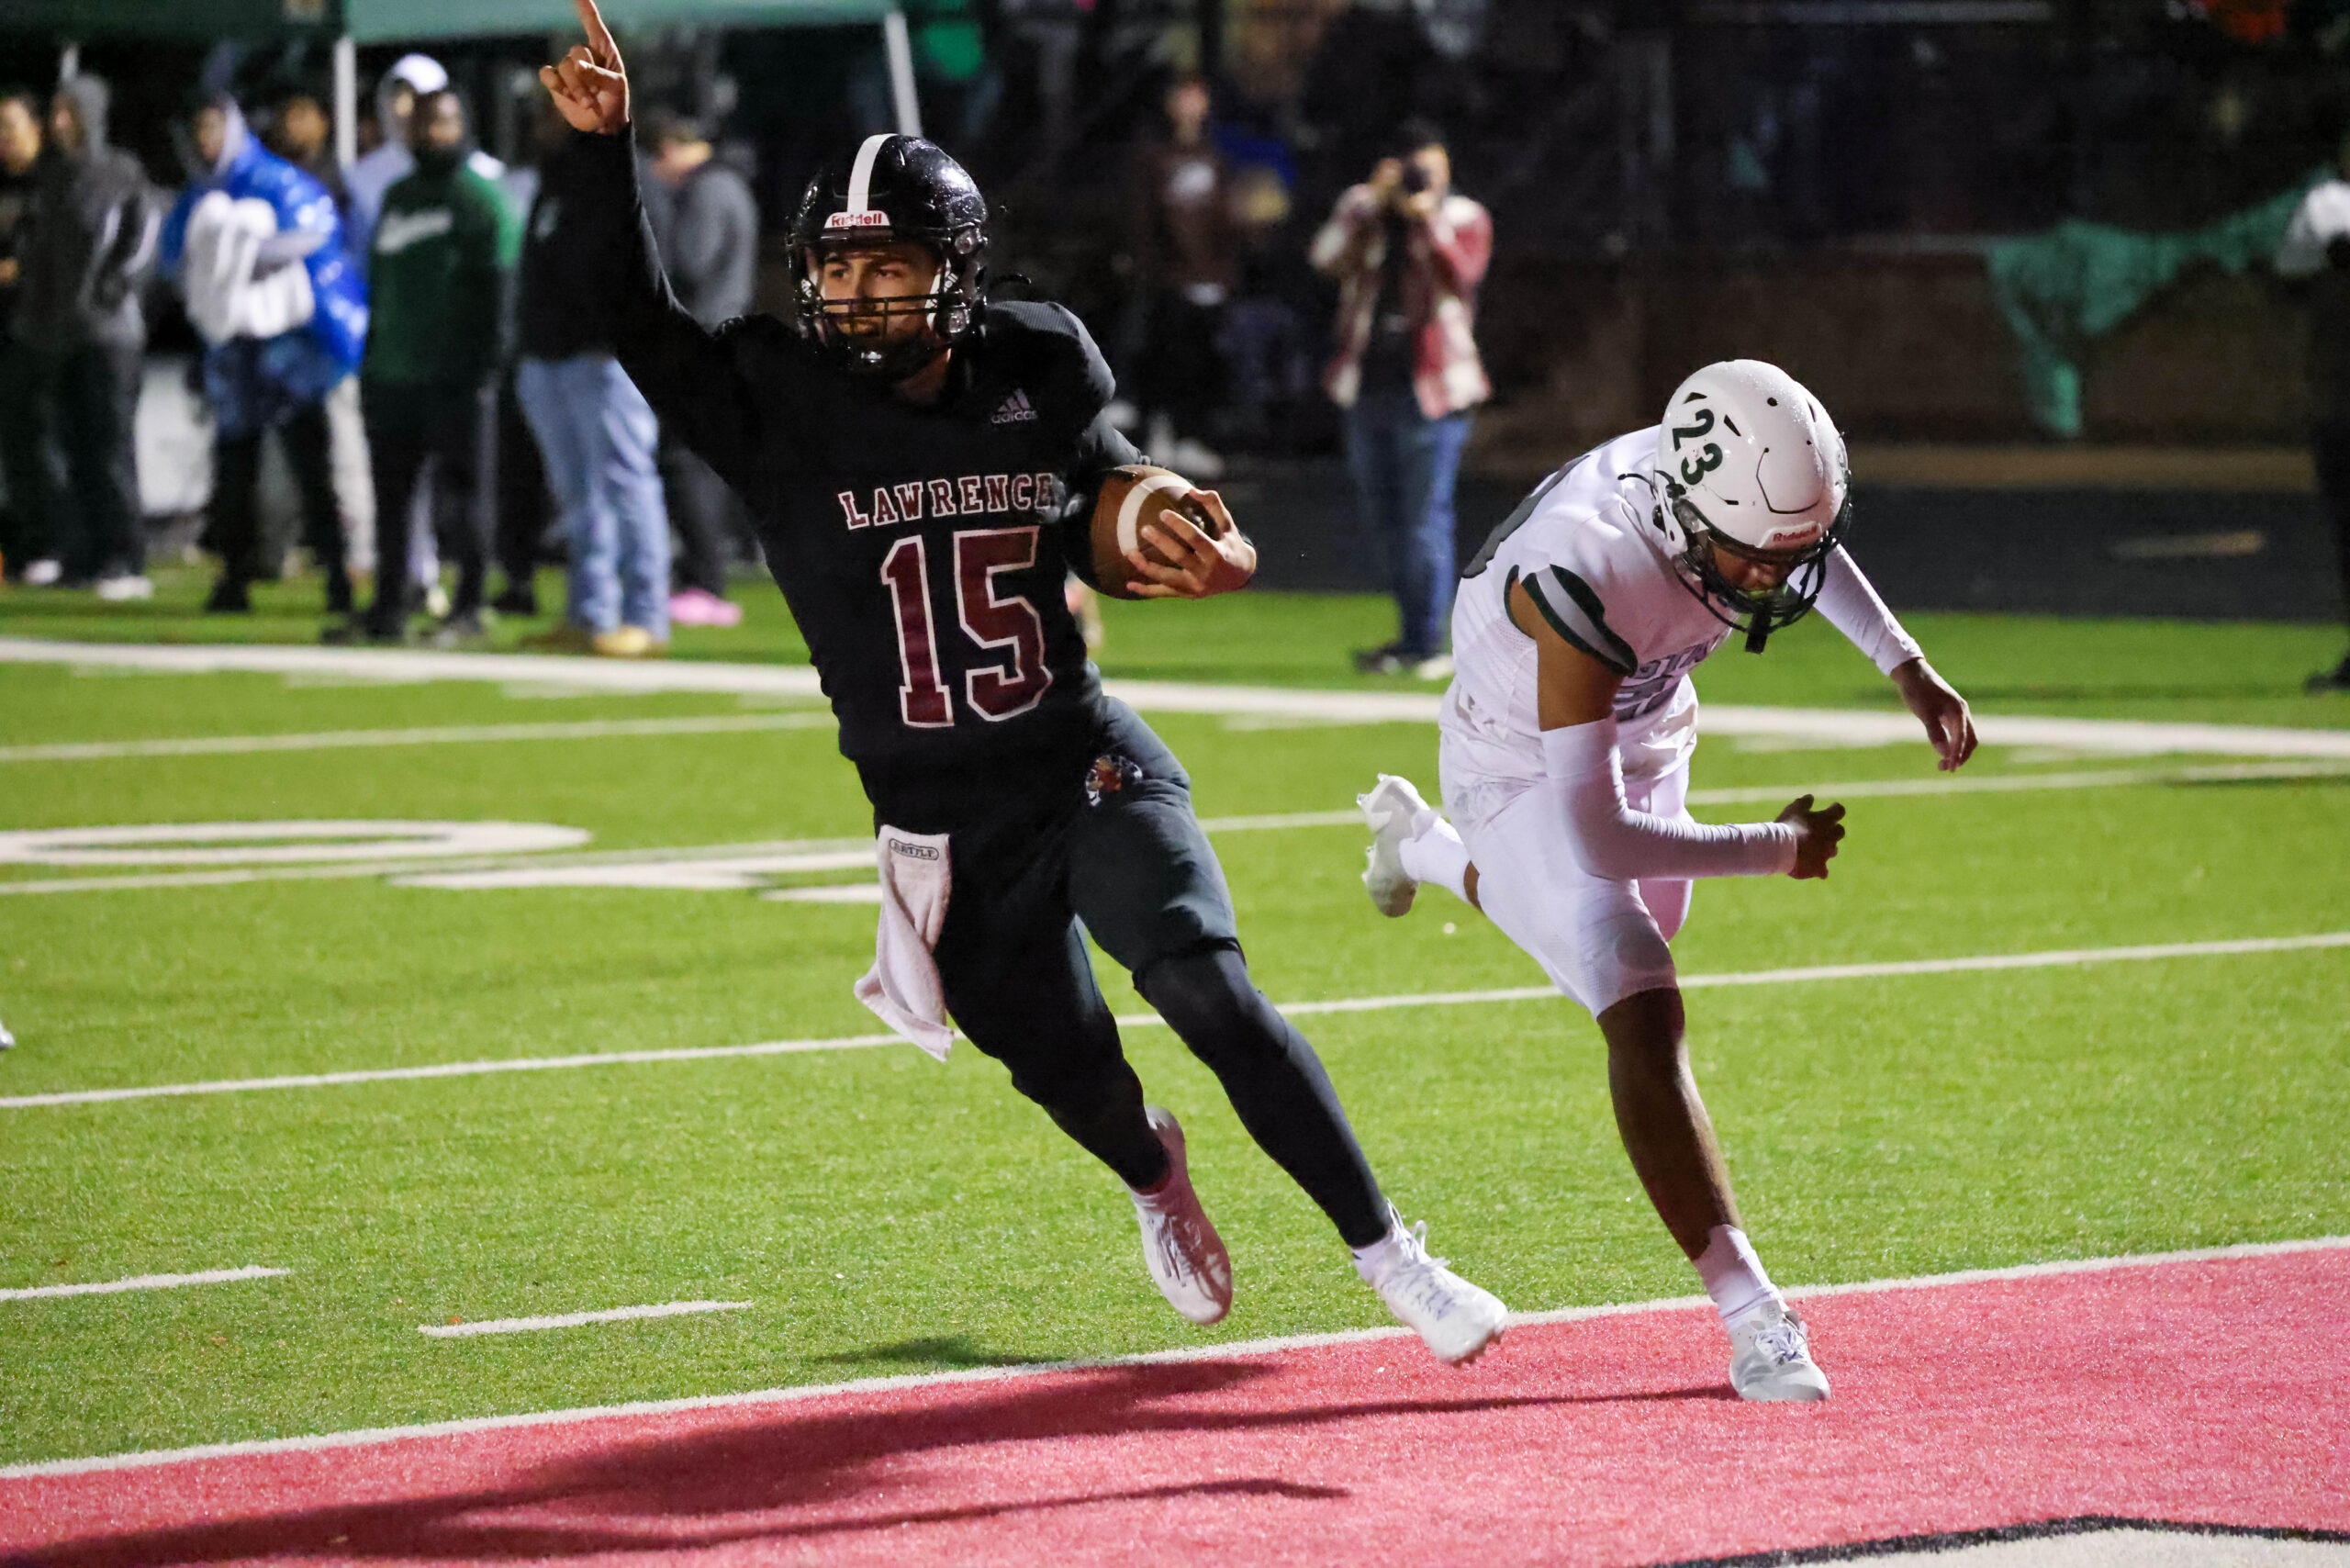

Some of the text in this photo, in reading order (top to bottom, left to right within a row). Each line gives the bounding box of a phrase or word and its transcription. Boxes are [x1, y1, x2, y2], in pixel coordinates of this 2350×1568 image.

[990, 410, 1038, 423] adidas
[1672, 408, 1723, 486] 23
[838, 472, 1054, 531] LAWRENCE
[879, 525, 1053, 728] 15
